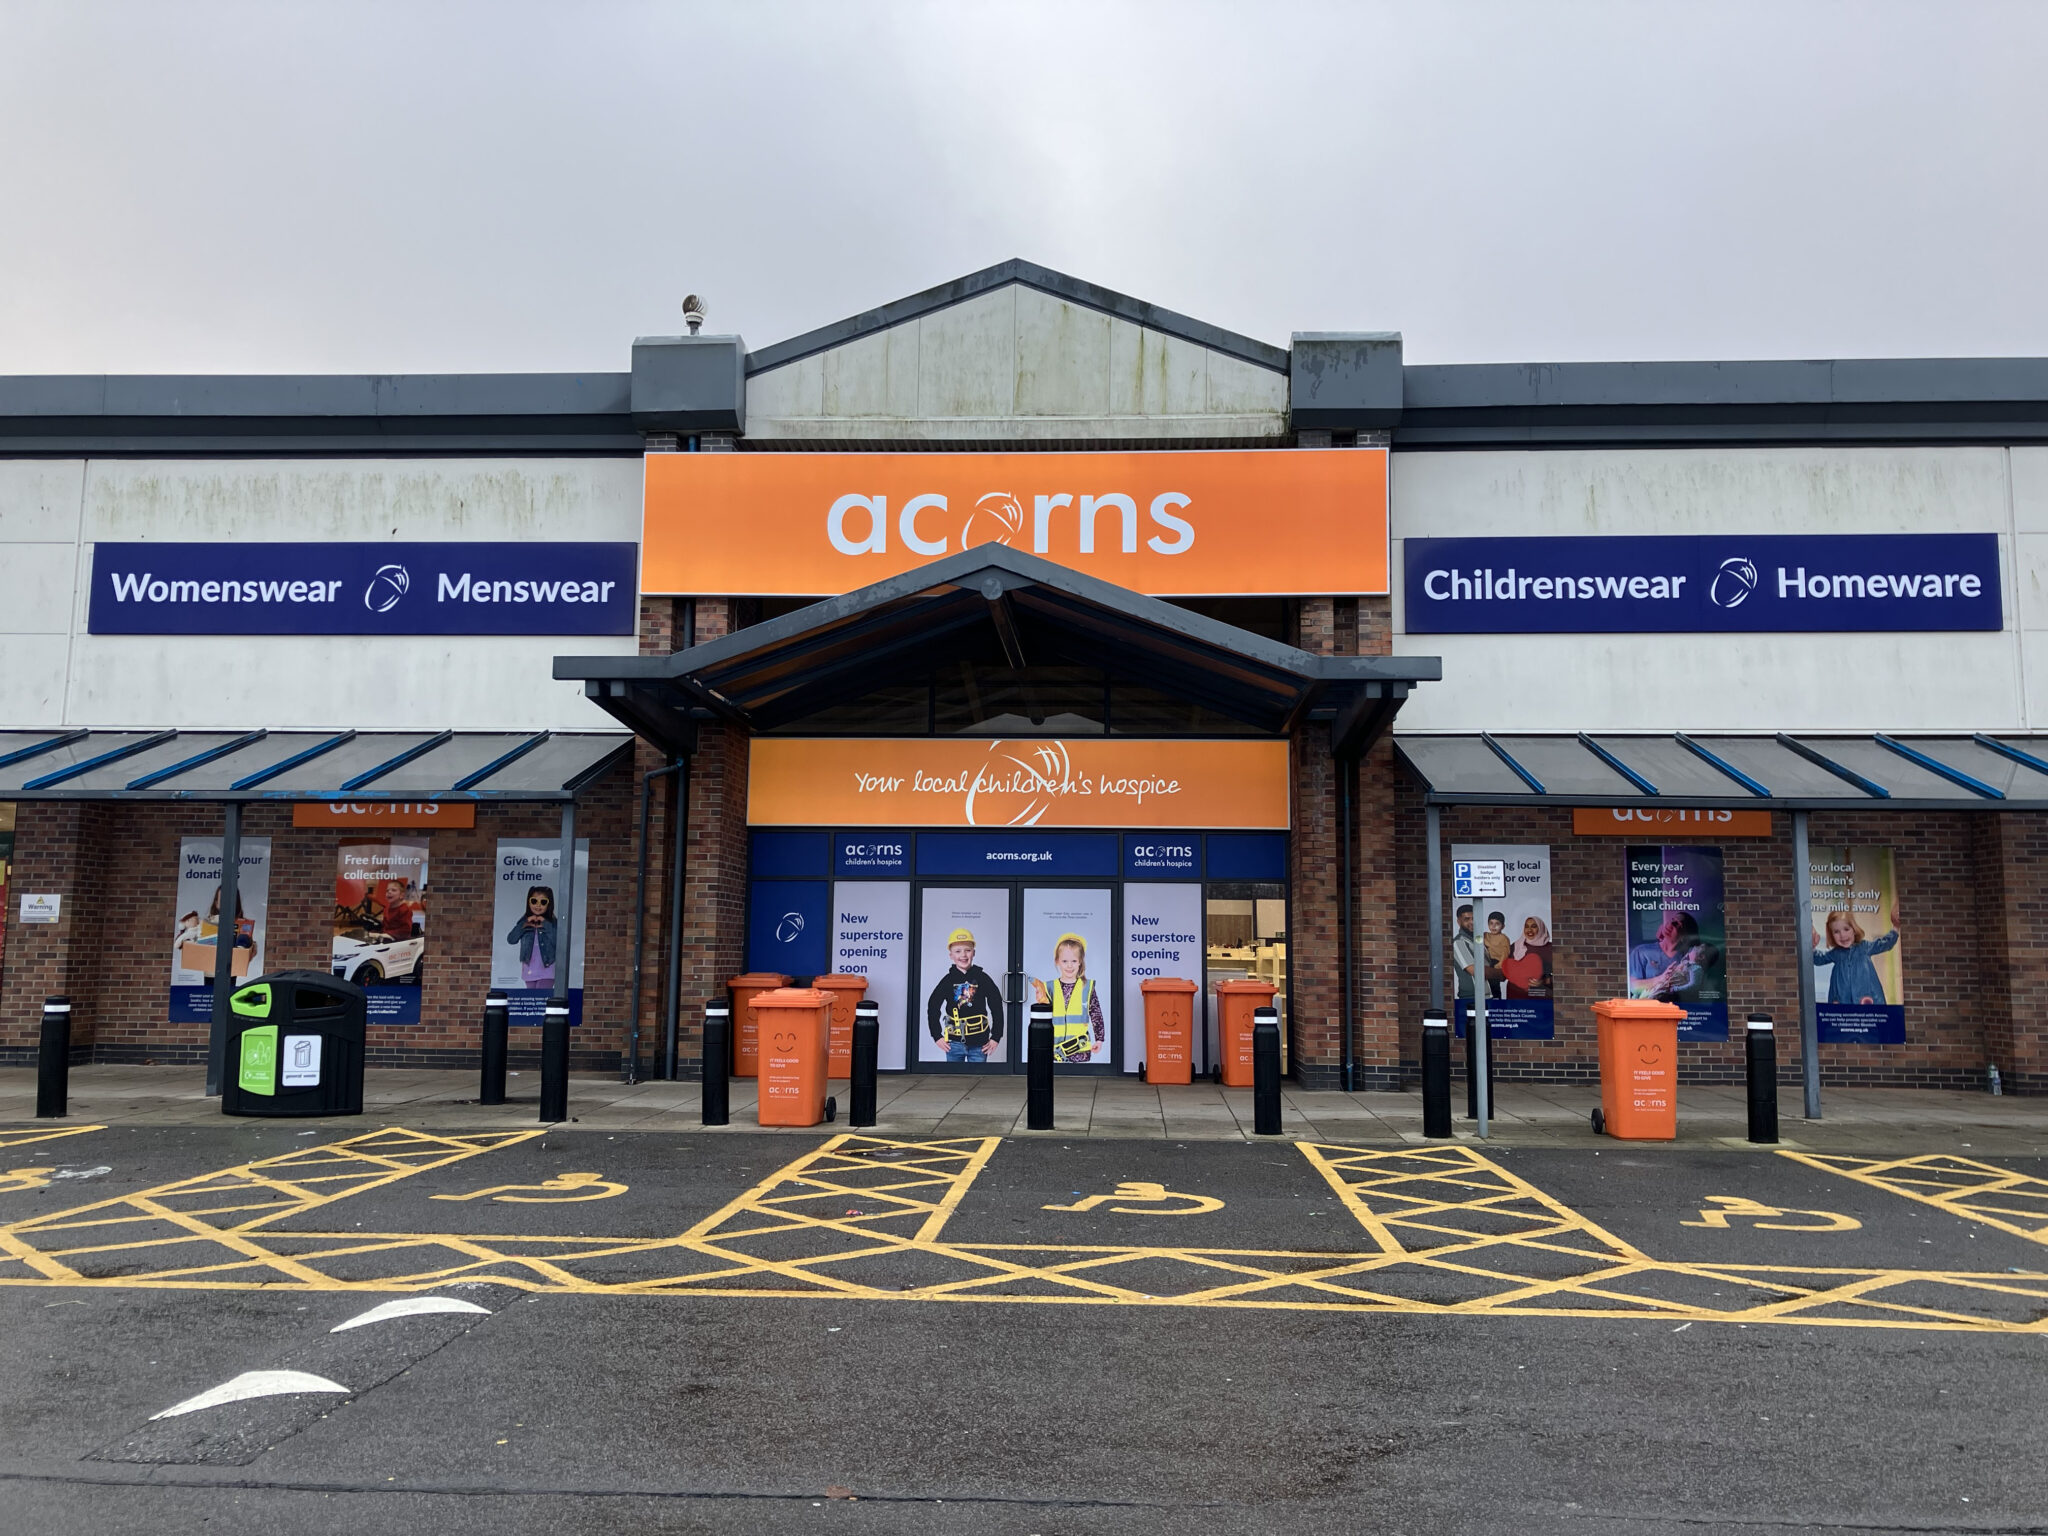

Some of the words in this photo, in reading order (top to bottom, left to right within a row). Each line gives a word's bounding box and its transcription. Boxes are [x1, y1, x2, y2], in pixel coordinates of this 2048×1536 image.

[827, 491, 1195, 556] acorns
[110, 572, 342, 604] Womenswear
[437, 572, 616, 604] Menswear
[1423, 568, 1687, 601] Childrenswear
[1778, 566, 1982, 599] Homeware
[854, 771, 905, 793] Your
[912, 769, 969, 793] local
[976, 770, 1093, 795] children's
[1100, 774, 1182, 805] hospice
[845, 843, 903, 856] acorns
[1134, 844, 1192, 858] acorns
[187, 854, 205, 864] We
[238, 857, 263, 866] your
[344, 854, 368, 864] Free
[372, 854, 420, 865] furniture
[503, 856, 528, 866] Give
[532, 856, 550, 866] the
[986, 850, 1053, 862] acorns.org.uk
[845, 858, 876, 866] children's
[877, 858, 902, 867] hospice
[1134, 859, 1166, 868] children's
[1167, 859, 1192, 869] hospice
[1517, 860, 1540, 869] local
[1631, 862, 1659, 872] Every
[1662, 863, 1684, 872] year
[1830, 862, 1854, 872] local
[186, 869, 240, 879] donatis
[344, 870, 398, 880] collection
[502, 870, 514, 880] of
[517, 870, 542, 880] time
[1458, 864, 1468, 876] P
[1632, 876, 1648, 884] we
[1649, 876, 1671, 884] care
[1674, 875, 1688, 884] for
[1810, 876, 1854, 885] hildren's
[1632, 888, 1679, 898] hundreds
[1682, 888, 1693, 898] of
[1847, 889, 1855, 898] is
[1858, 889, 1880, 900] only
[1632, 901, 1656, 911] local
[1659, 901, 1700, 911] children
[1828, 902, 1850, 912] mile
[1852, 905, 1879, 913] away
[840, 913, 868, 924] New
[1131, 915, 1159, 926] New
[840, 930, 904, 942] superstore
[1131, 932, 1196, 945] superstore
[840, 946, 888, 960] opening
[1131, 948, 1180, 962] opening
[839, 964, 868, 974] soon
[1131, 965, 1161, 976] soon
